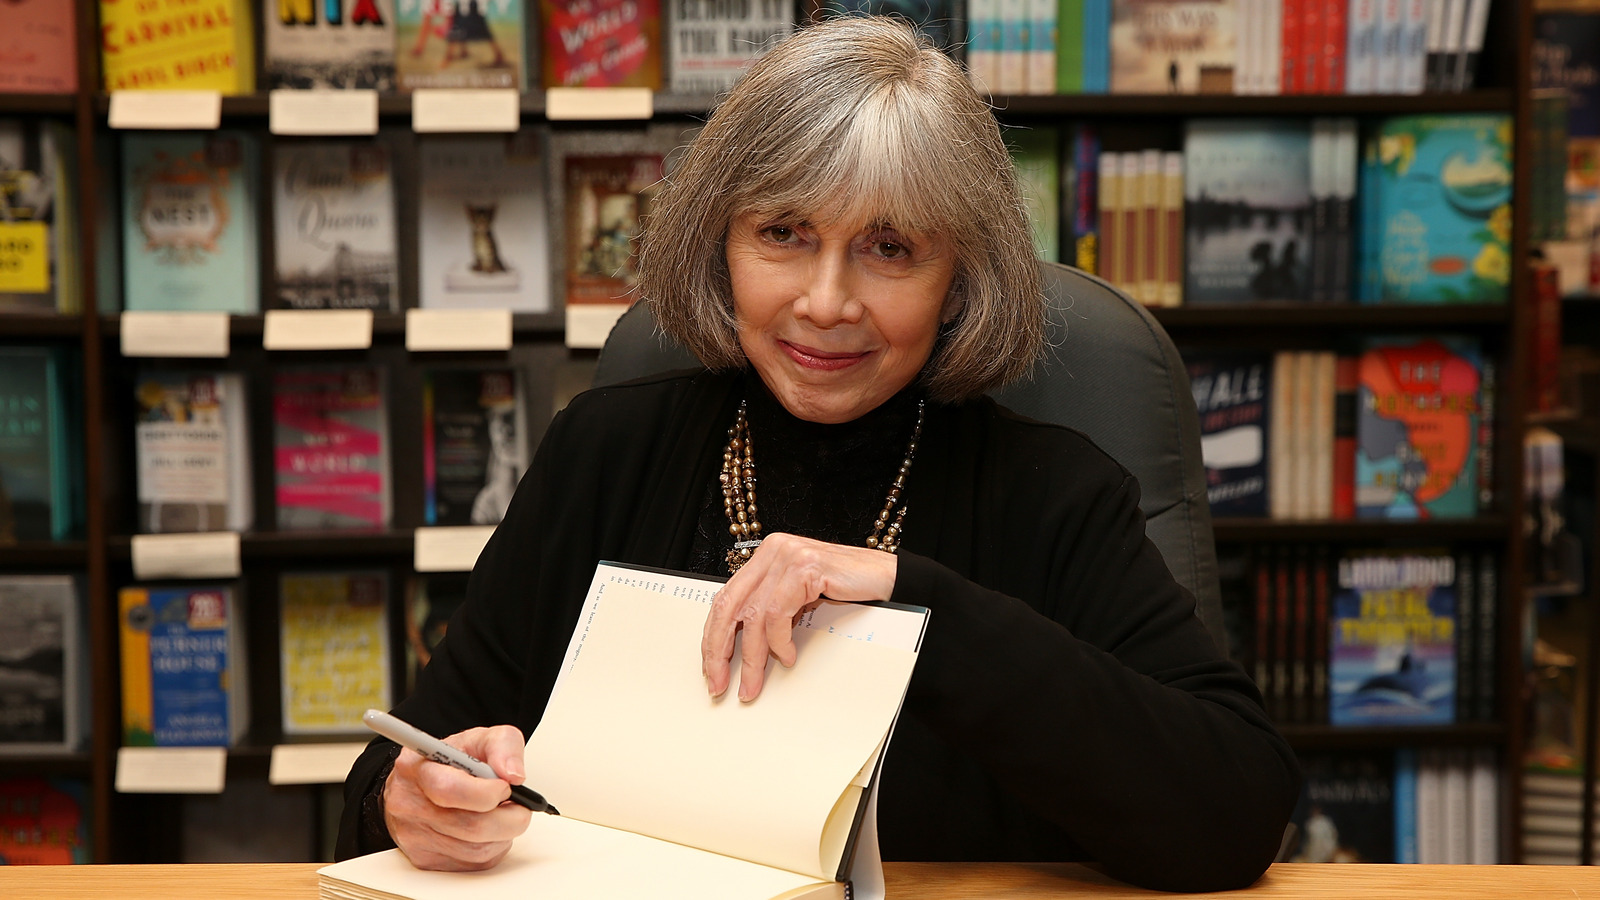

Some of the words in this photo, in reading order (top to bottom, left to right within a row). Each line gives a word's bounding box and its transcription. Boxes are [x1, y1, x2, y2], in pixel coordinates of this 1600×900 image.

[102, 5, 231, 53] CARNIVAL
[560, 1, 638, 54] WORLD
[151, 205, 210, 227] NEST
[1193, 364, 1263, 412] HALE
[291, 453, 367, 473] WORLD
